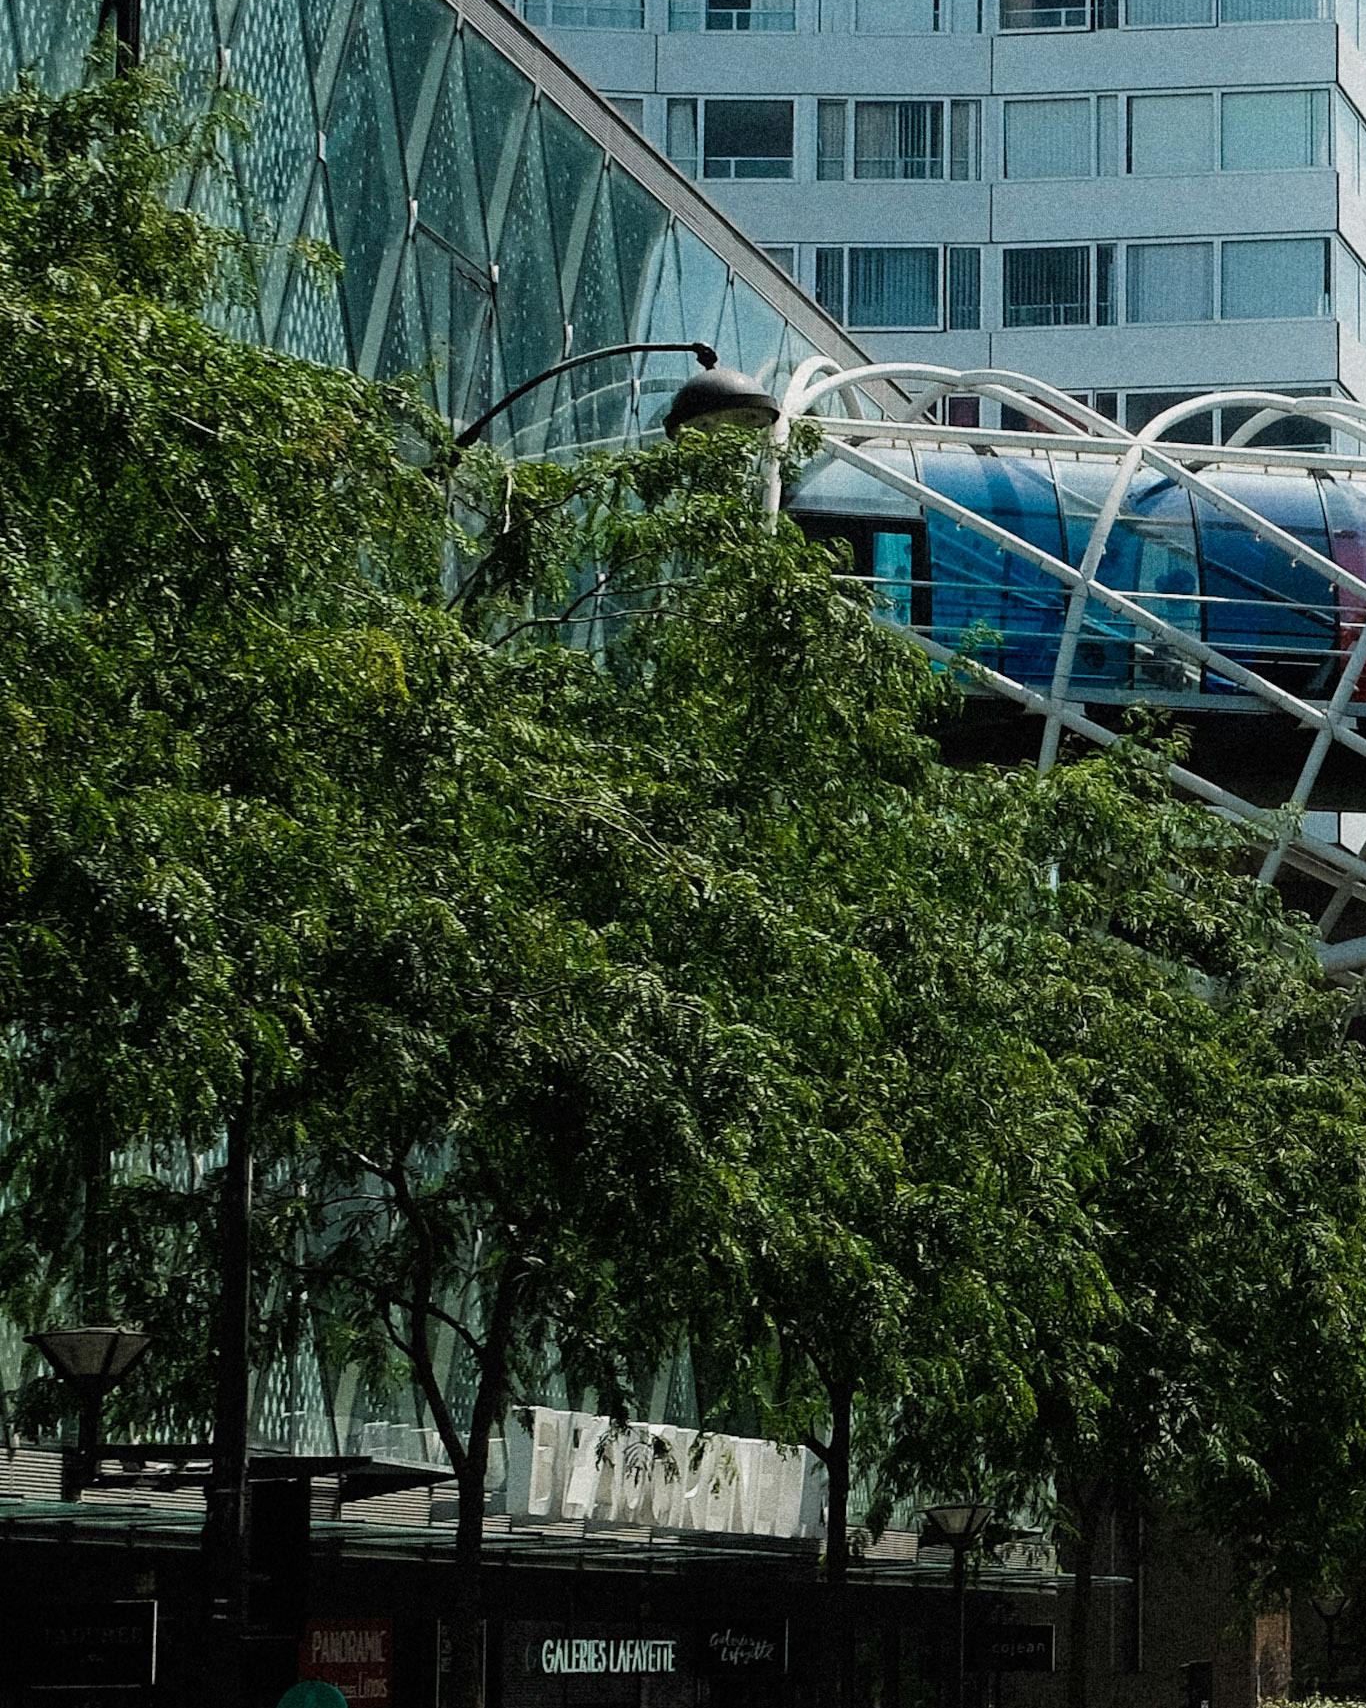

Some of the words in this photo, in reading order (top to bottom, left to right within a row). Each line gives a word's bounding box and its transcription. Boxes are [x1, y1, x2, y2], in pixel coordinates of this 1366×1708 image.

[541, 1639, 607, 1674] GALERIES
[608, 1639, 677, 1674] LAFAYETTE
[991, 1640, 1046, 1658] cojean
